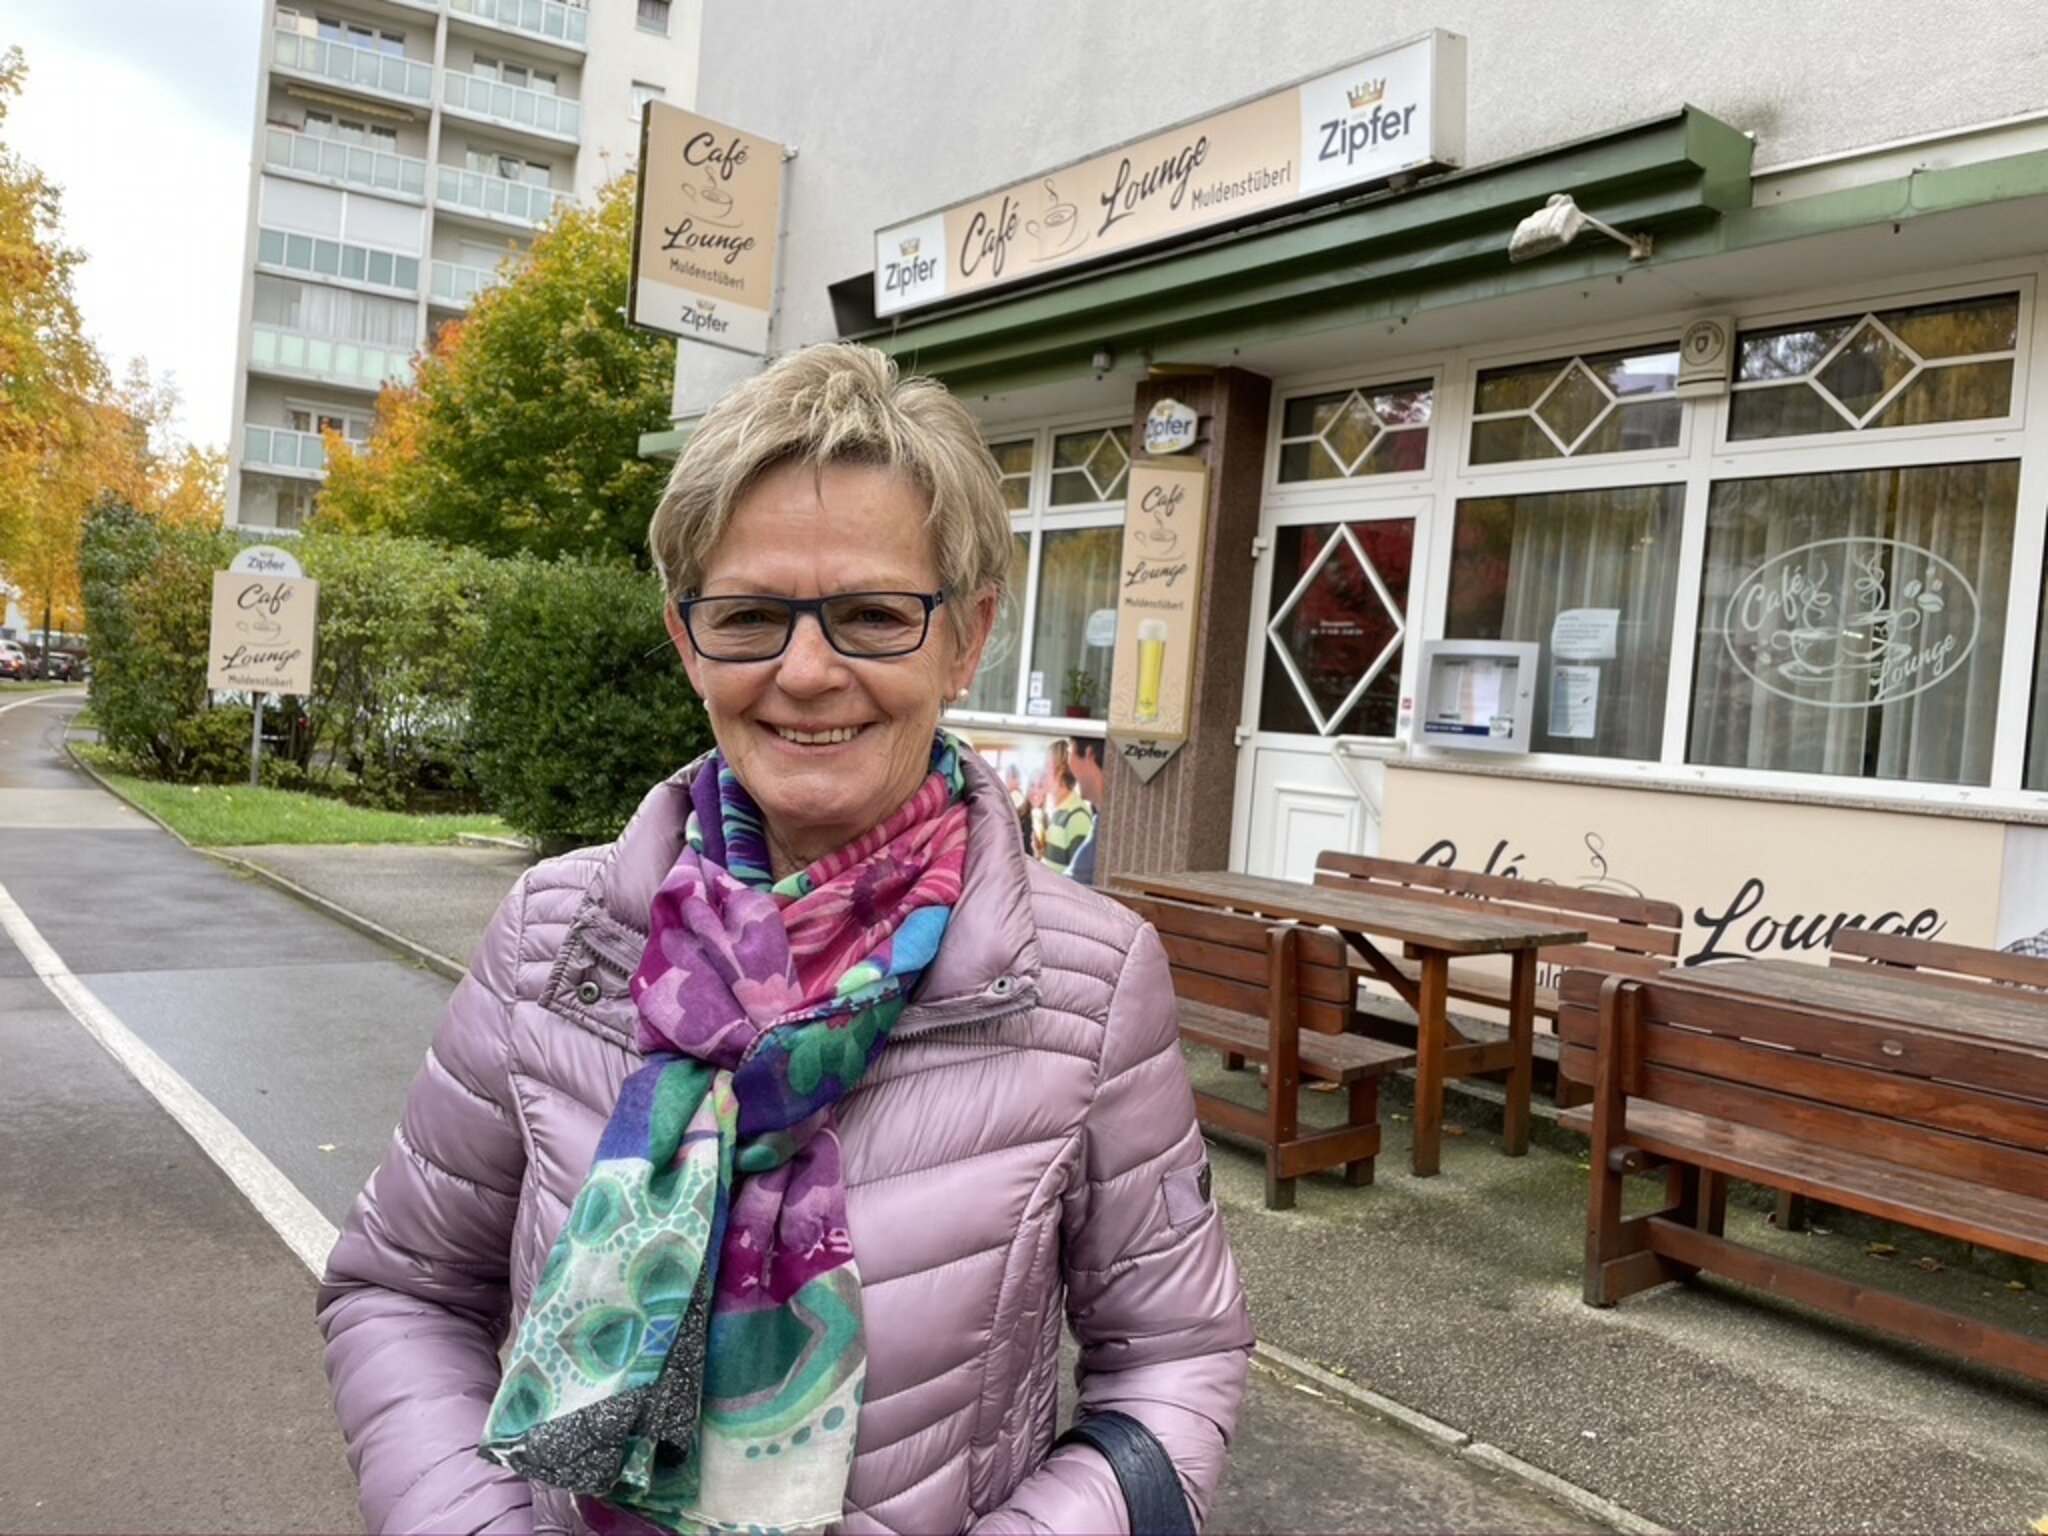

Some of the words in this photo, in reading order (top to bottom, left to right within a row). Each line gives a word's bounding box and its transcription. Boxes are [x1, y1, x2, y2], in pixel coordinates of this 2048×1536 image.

[1319, 104, 1416, 165] Zipfer
[683, 132, 749, 181] Café
[1191, 160, 1291, 212] Muldenstüberl
[959, 196, 1019, 278] Café
[1097, 135, 1207, 237] Lounge
[661, 217, 755, 264] Lounge
[669, 256, 745, 290] Muldenstüberl
[884, 254, 937, 295] Zipfer
[680, 305, 729, 333] Zipfer
[1141, 484, 1185, 517] Café
[248, 556, 286, 571] Zipfer
[1125, 561, 1188, 587] Lounge
[237, 583, 294, 615] Café
[1742, 565, 1804, 631] Café
[220, 645, 301, 671] Lounge
[1124, 744, 1170, 760] Zipfer
